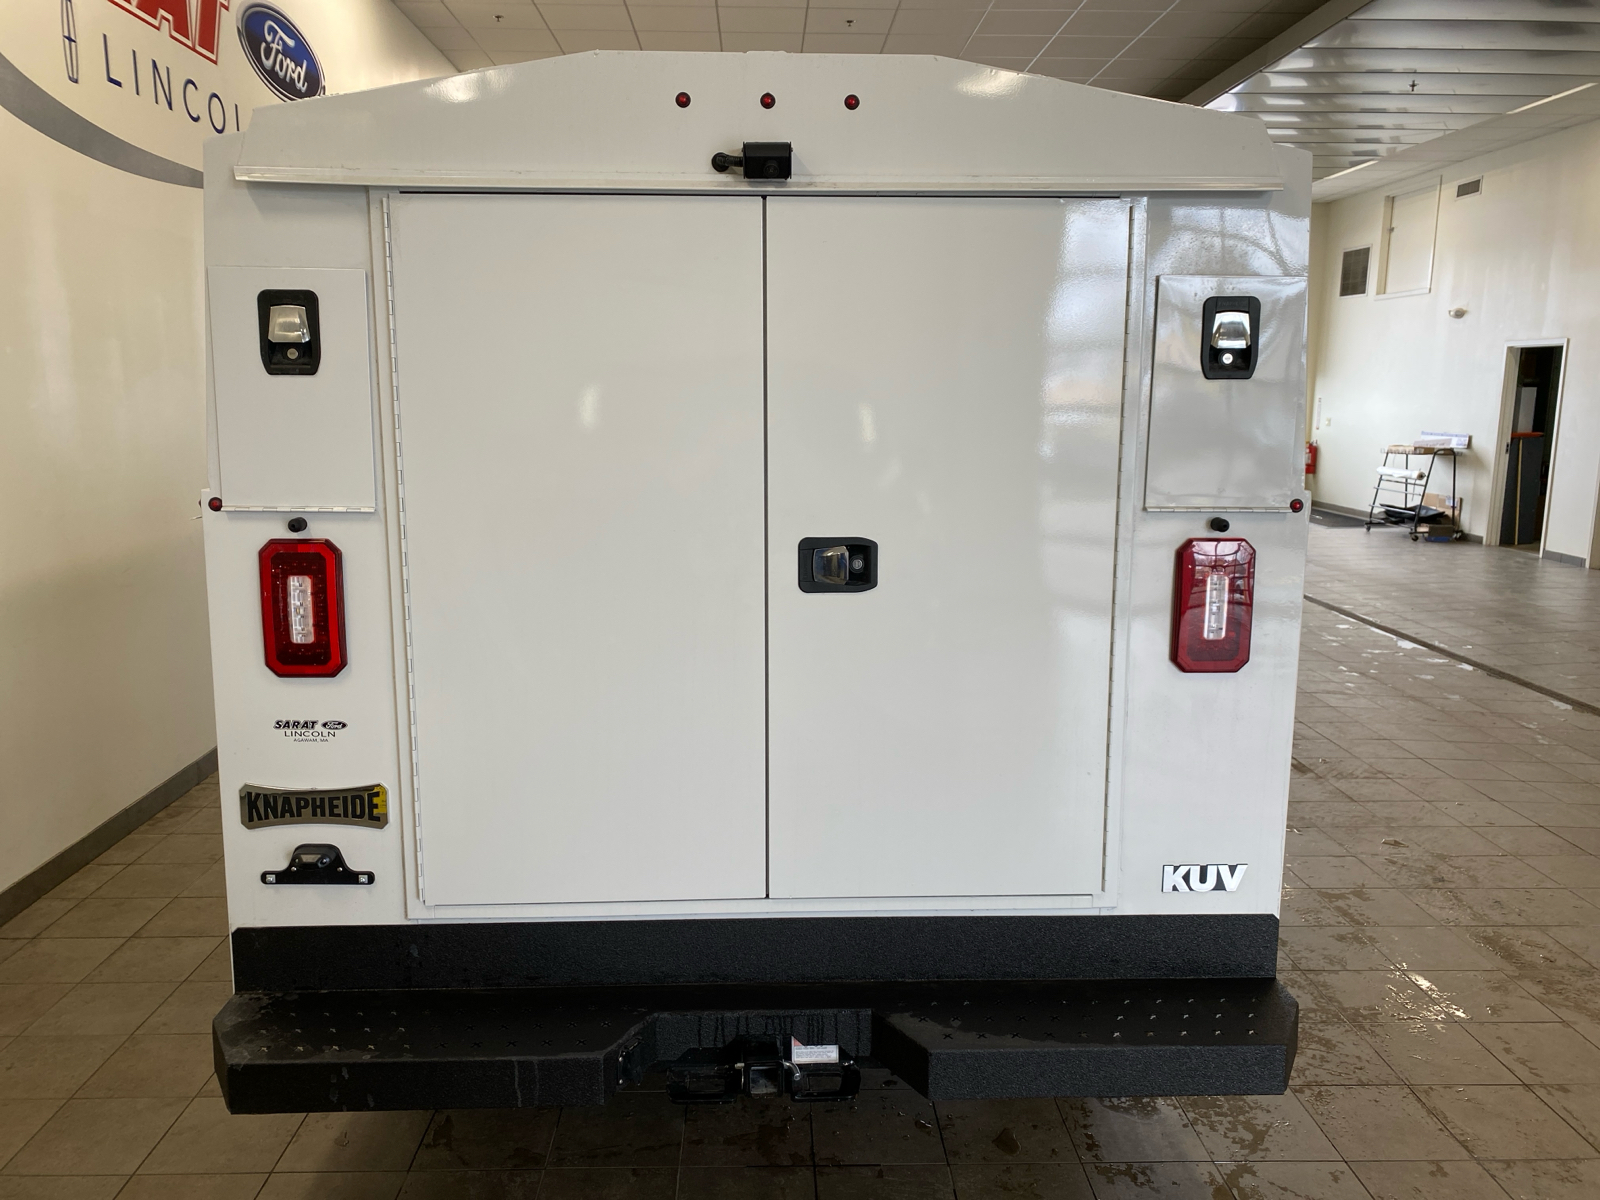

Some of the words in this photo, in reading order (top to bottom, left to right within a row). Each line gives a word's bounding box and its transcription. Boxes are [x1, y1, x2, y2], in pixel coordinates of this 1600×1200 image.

[260, 20, 308, 93] Ford
[273, 720, 318, 730] SARAT
[323, 720, 346, 730] Ford
[284, 730, 336, 738] LINCOLN
[246, 791, 381, 823] KNAPHEIDE
[1161, 863, 1249, 893] KUV
